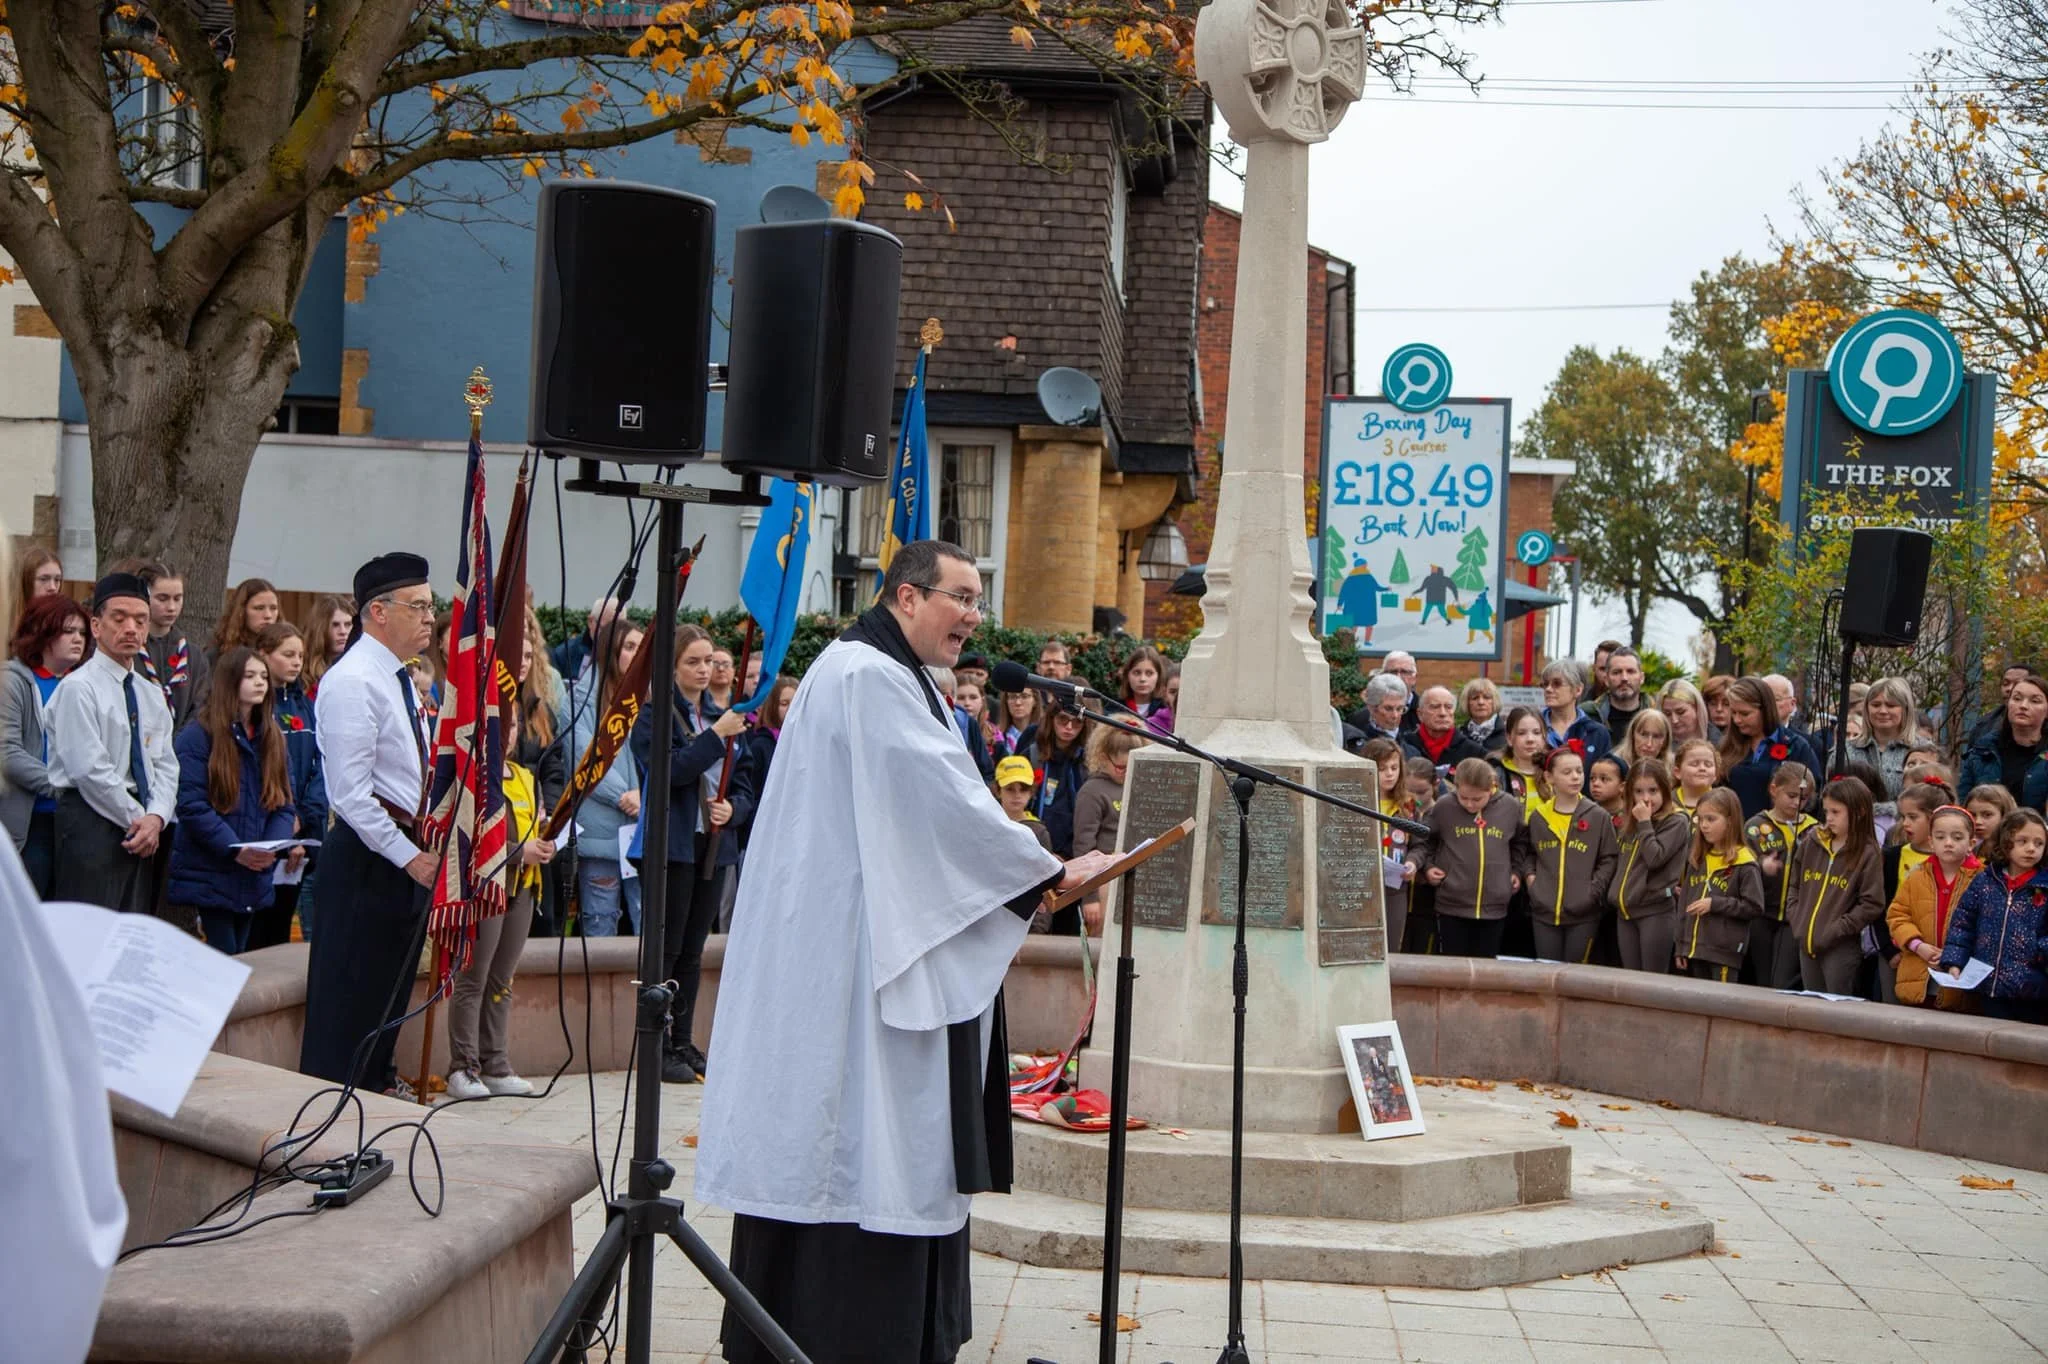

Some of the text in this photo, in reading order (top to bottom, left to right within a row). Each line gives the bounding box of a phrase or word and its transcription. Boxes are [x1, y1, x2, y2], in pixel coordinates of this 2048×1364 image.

[1358, 408, 1472, 440] Boxing Day
[1383, 437, 1448, 457] 3 Courses
[1334, 460, 1494, 508] £18.49
[1826, 464, 1952, 487] THE FOX
[1355, 509, 1467, 545] Book Now!
